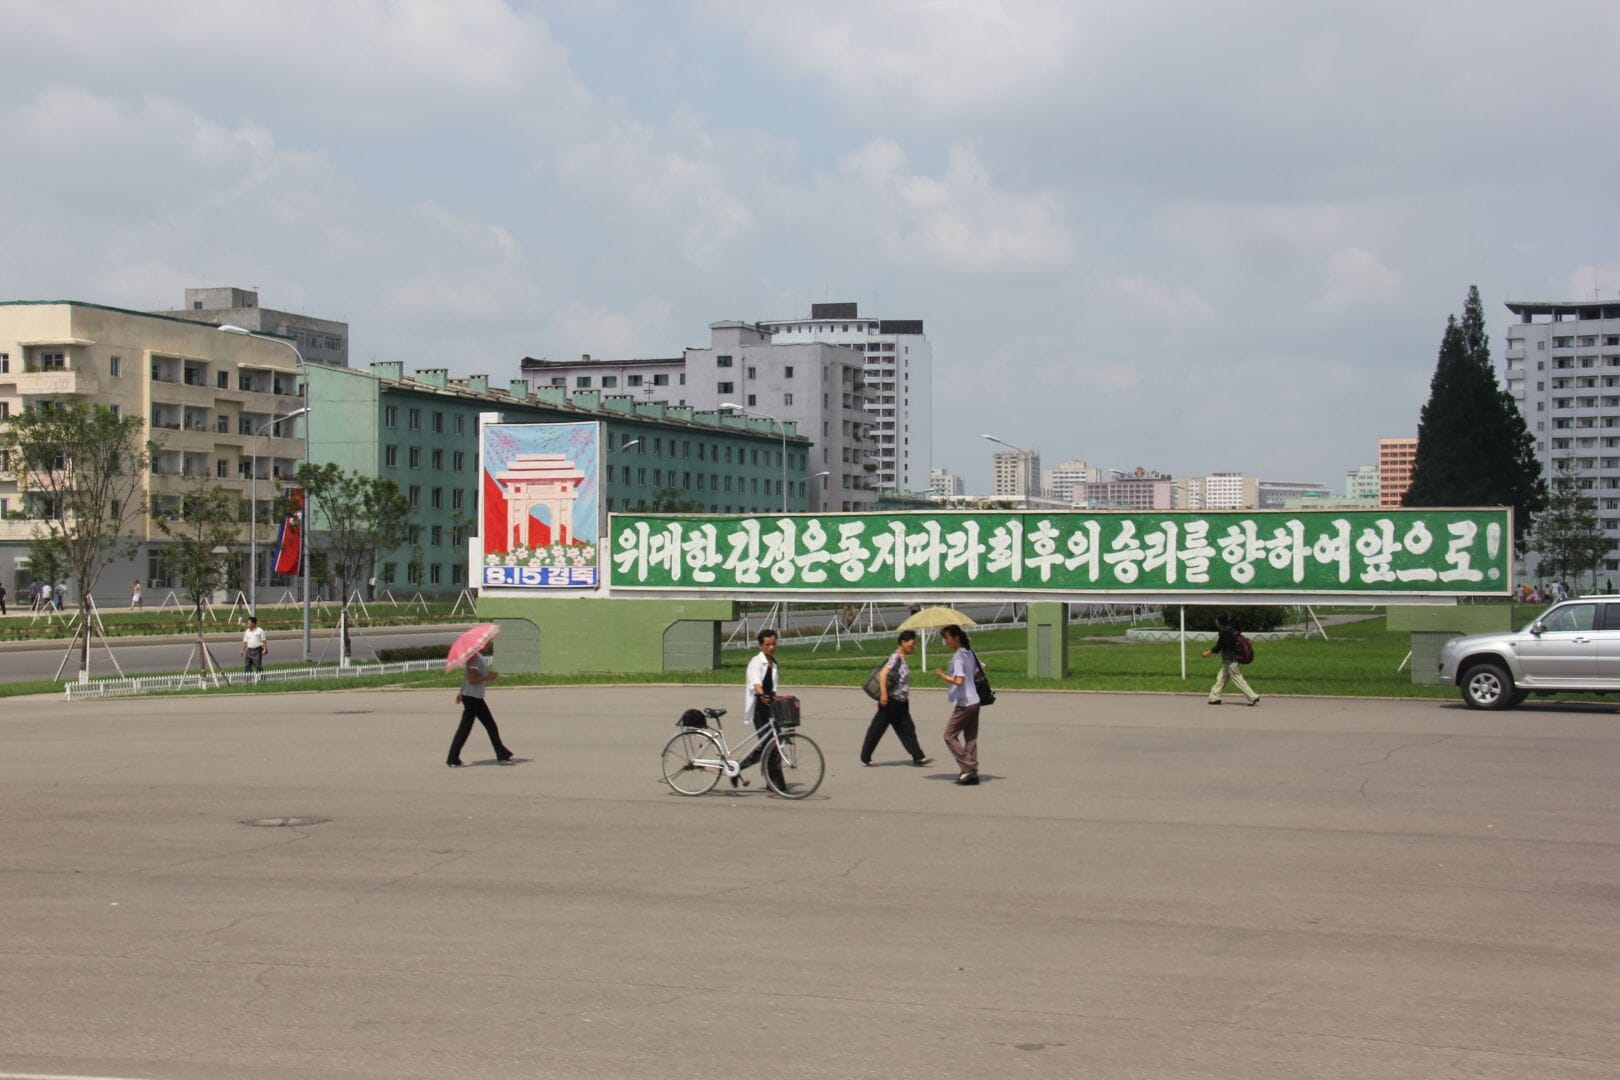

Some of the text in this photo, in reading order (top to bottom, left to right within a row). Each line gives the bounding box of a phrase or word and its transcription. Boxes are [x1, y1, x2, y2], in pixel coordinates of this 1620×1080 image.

[613, 520, 722, 582] 위대한
[1103, 519, 1216, 584] 승리를
[1217, 518, 1351, 583] 향하여
[486, 567, 594, 585] 8.15 경축
